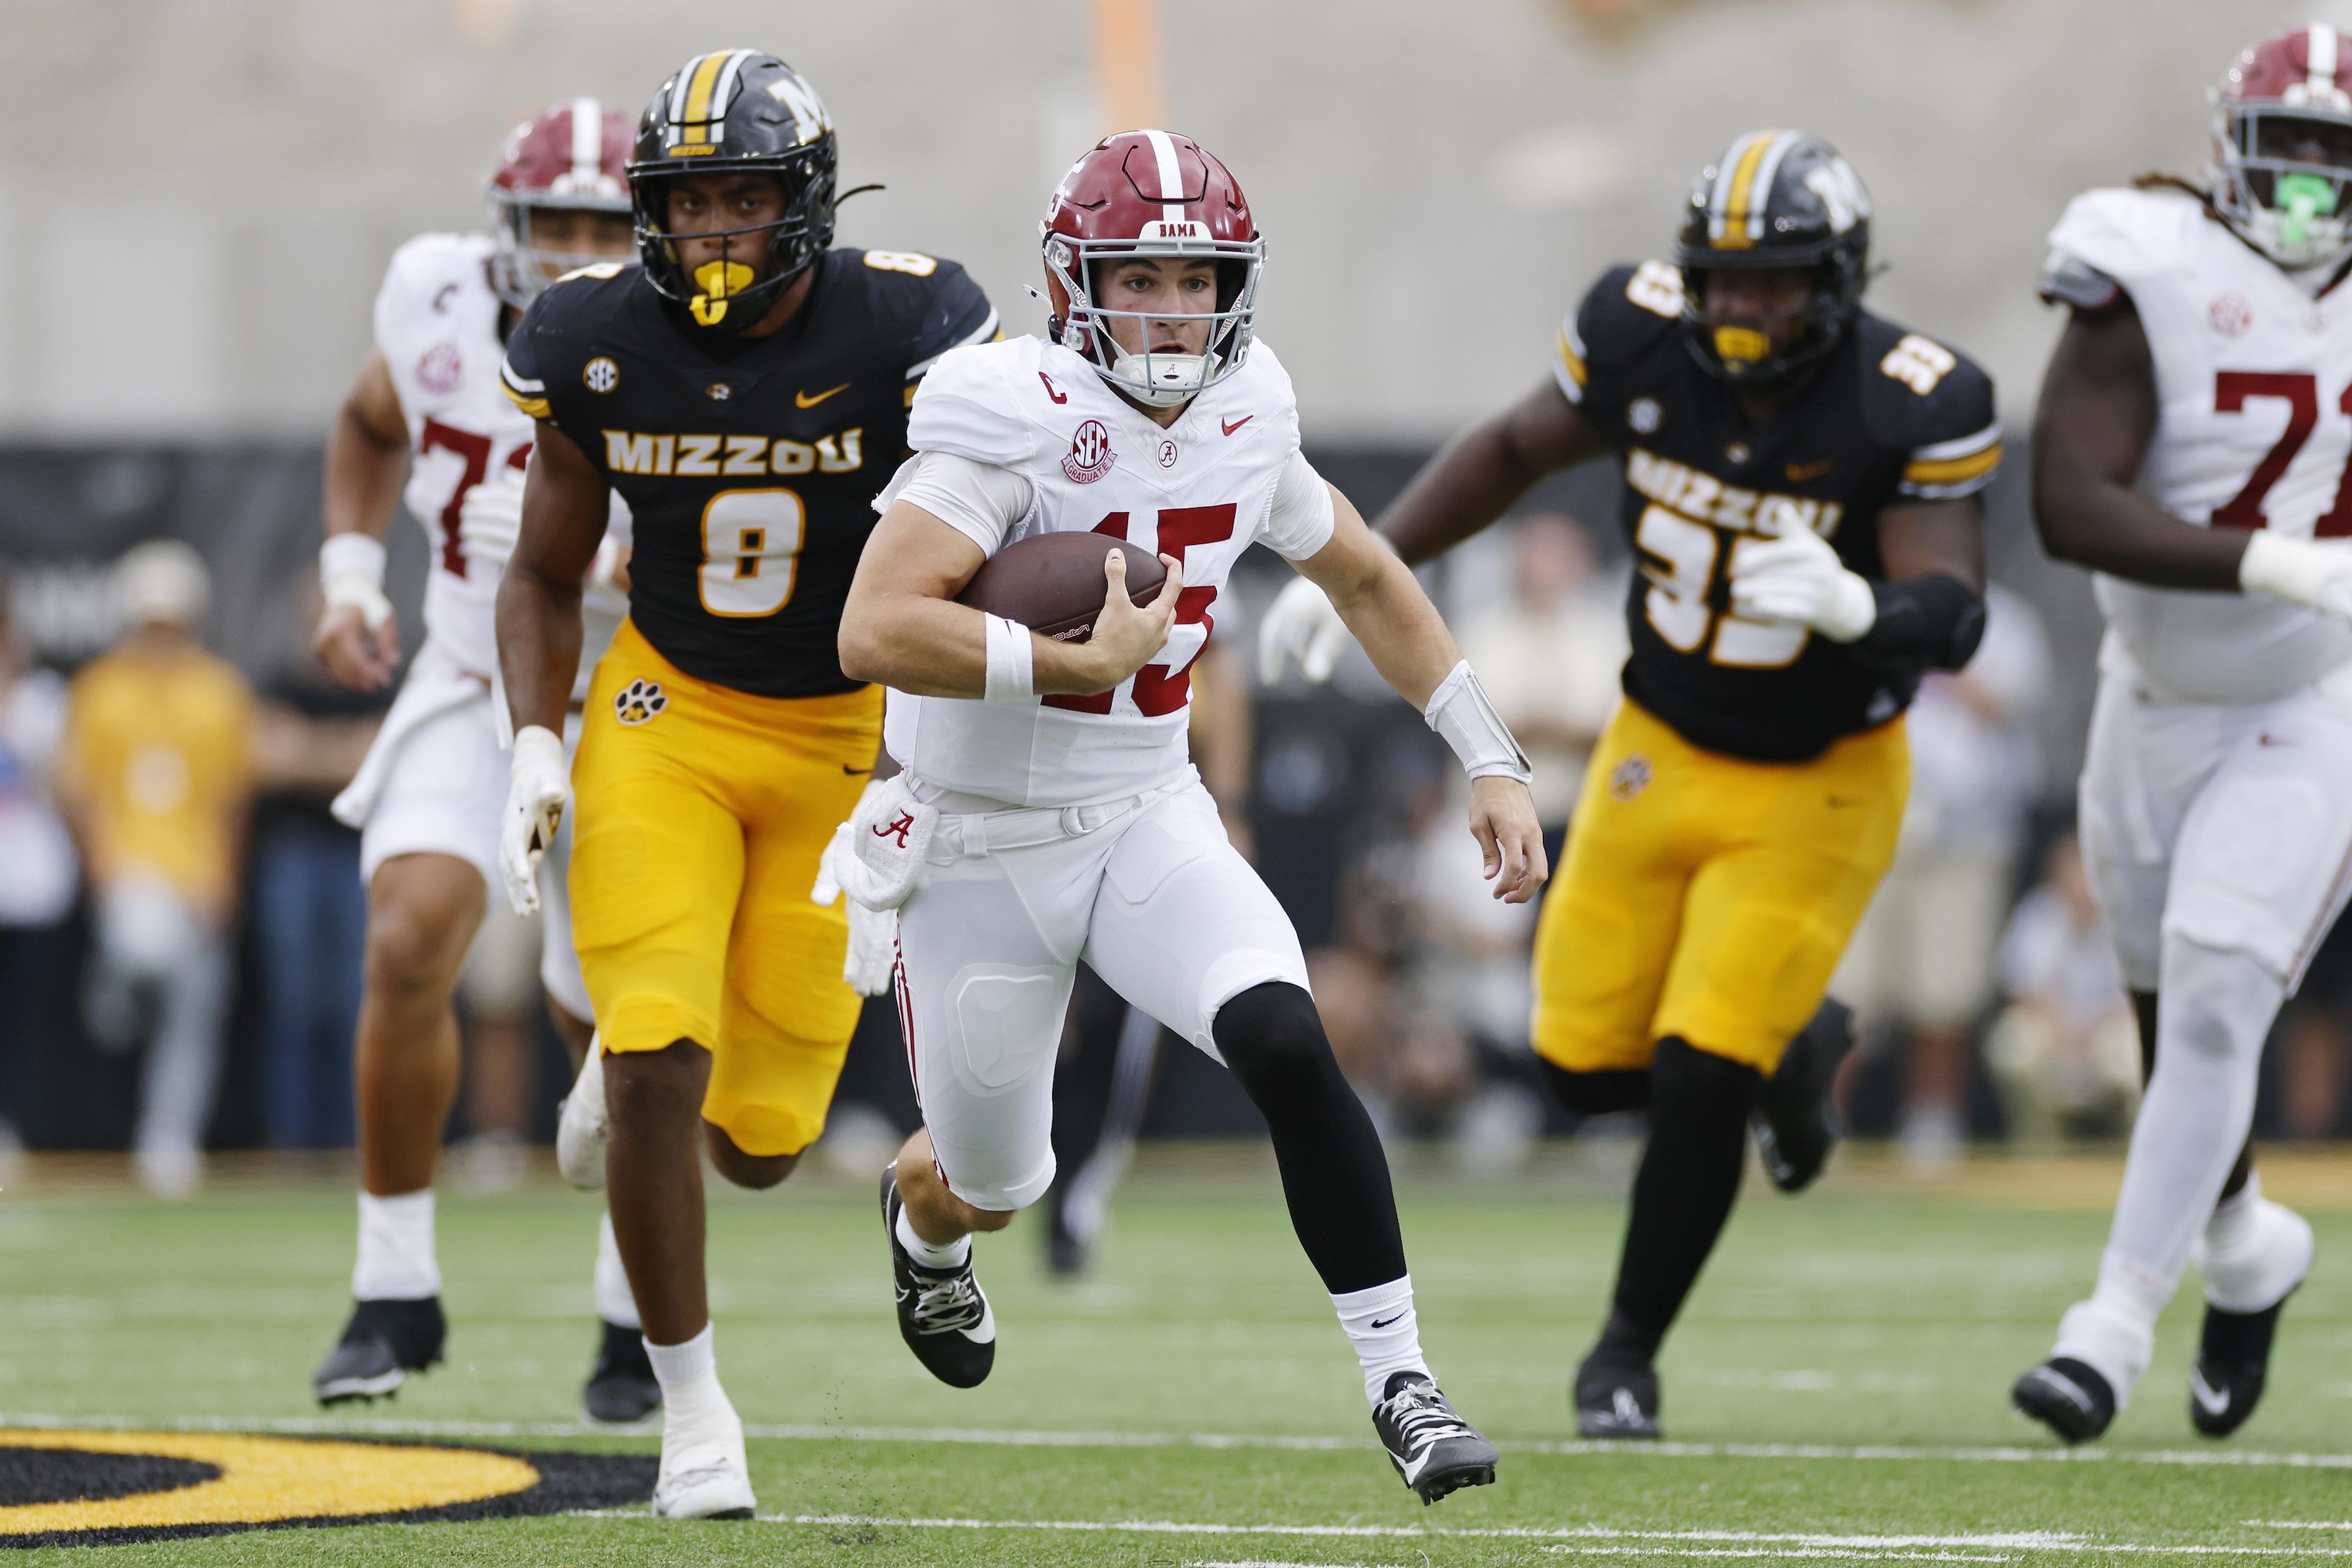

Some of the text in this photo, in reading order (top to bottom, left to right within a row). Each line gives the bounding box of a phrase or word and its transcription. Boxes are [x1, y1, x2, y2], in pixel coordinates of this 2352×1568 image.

[1159, 223, 1196, 238] BAMA
[863, 250, 938, 278] 8
[587, 358, 616, 392] SEC
[1166, 363, 1176, 372] A
[1038, 371, 1068, 405] C
[601, 427, 863, 476] MIZZOU
[1074, 422, 1107, 467] SEC
[1160, 444, 1174, 463] A
[1066, 461, 1110, 482] GRADUATE
[422, 416, 534, 579] 7
[697, 486, 807, 618] 8
[872, 808, 915, 849] A
